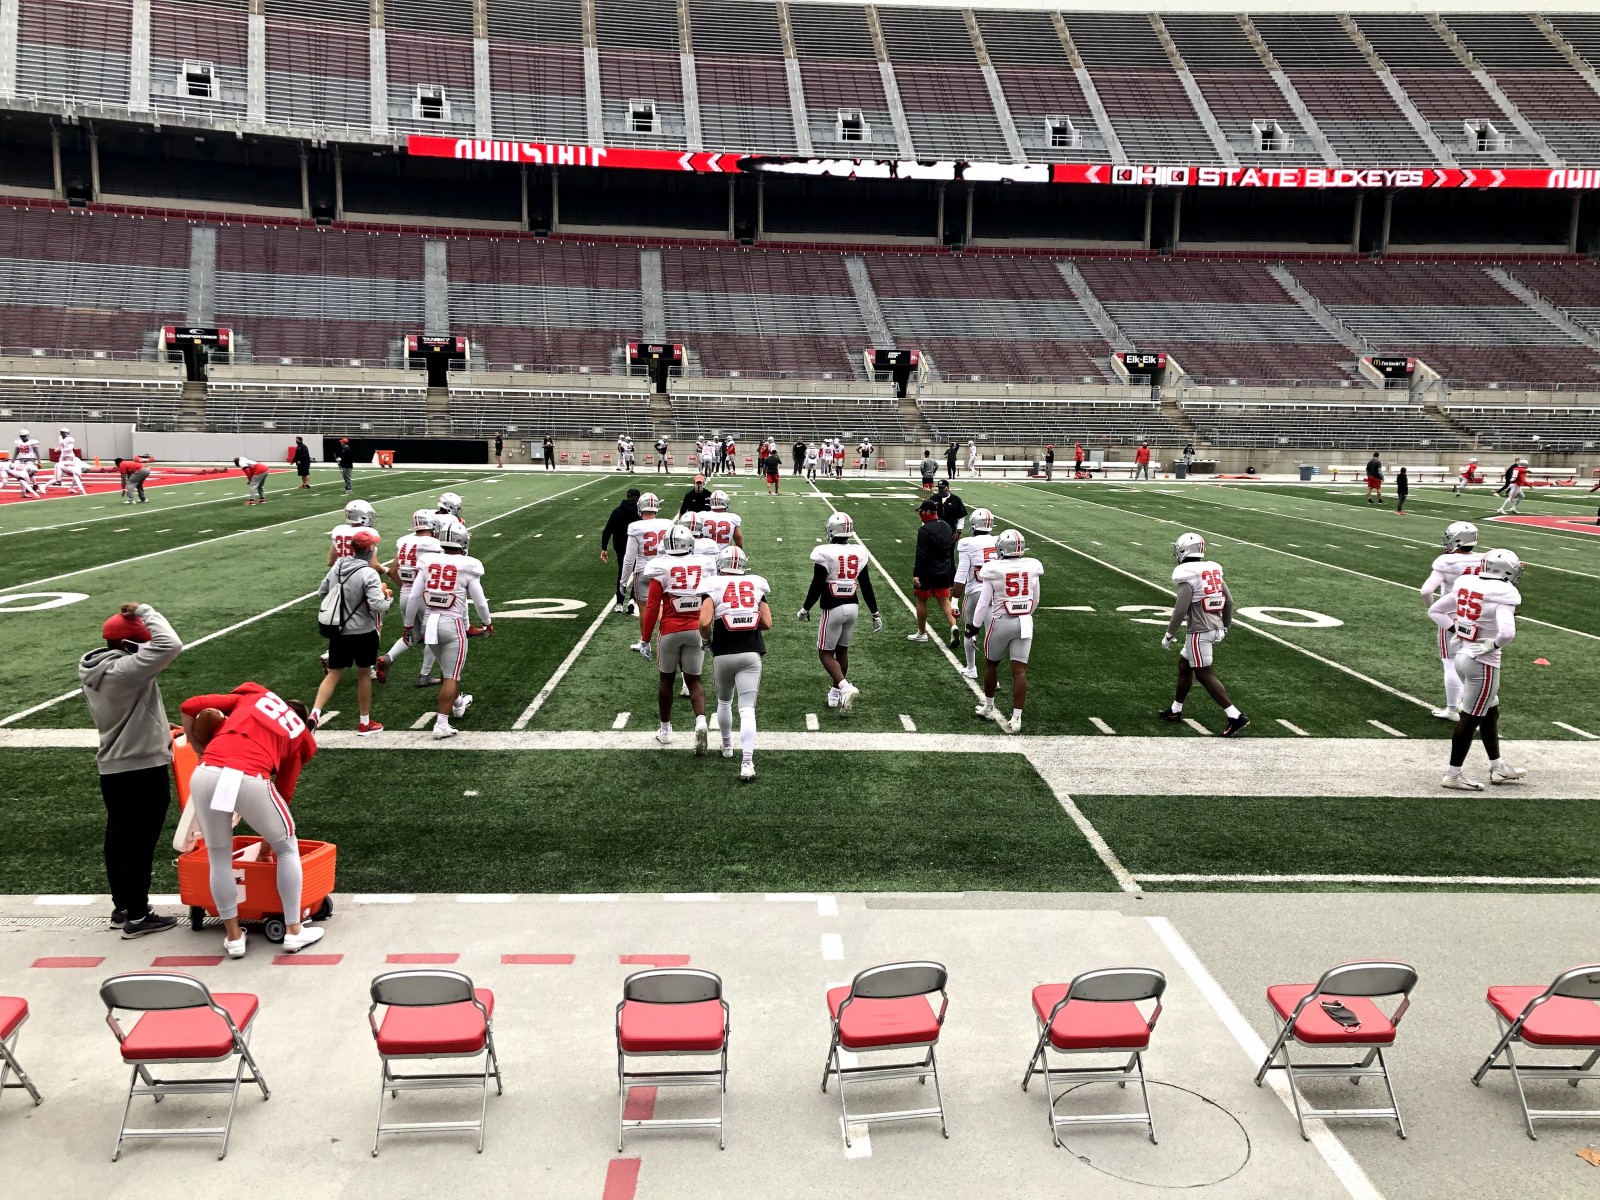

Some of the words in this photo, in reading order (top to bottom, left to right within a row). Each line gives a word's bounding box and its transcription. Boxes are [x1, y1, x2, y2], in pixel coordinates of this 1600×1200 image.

[1112, 166, 1190, 186] OHIO
[1198, 167, 1299, 187] STATE
[1305, 169, 1424, 188] BUCKEYES
[703, 519, 731, 544] 32
[398, 542, 418, 567] 44
[838, 554, 859, 579] 19
[426, 563, 458, 592] 39
[670, 565, 702, 590] 37
[1005, 571, 1029, 597] 51
[429, 596, 449, 604] DOUGLAS
[679, 601, 700, 609] DOUGLAS
[722, 581, 755, 609] 46
[732, 616, 754, 624] DOUGLAS
[254, 691, 306, 740] 89
